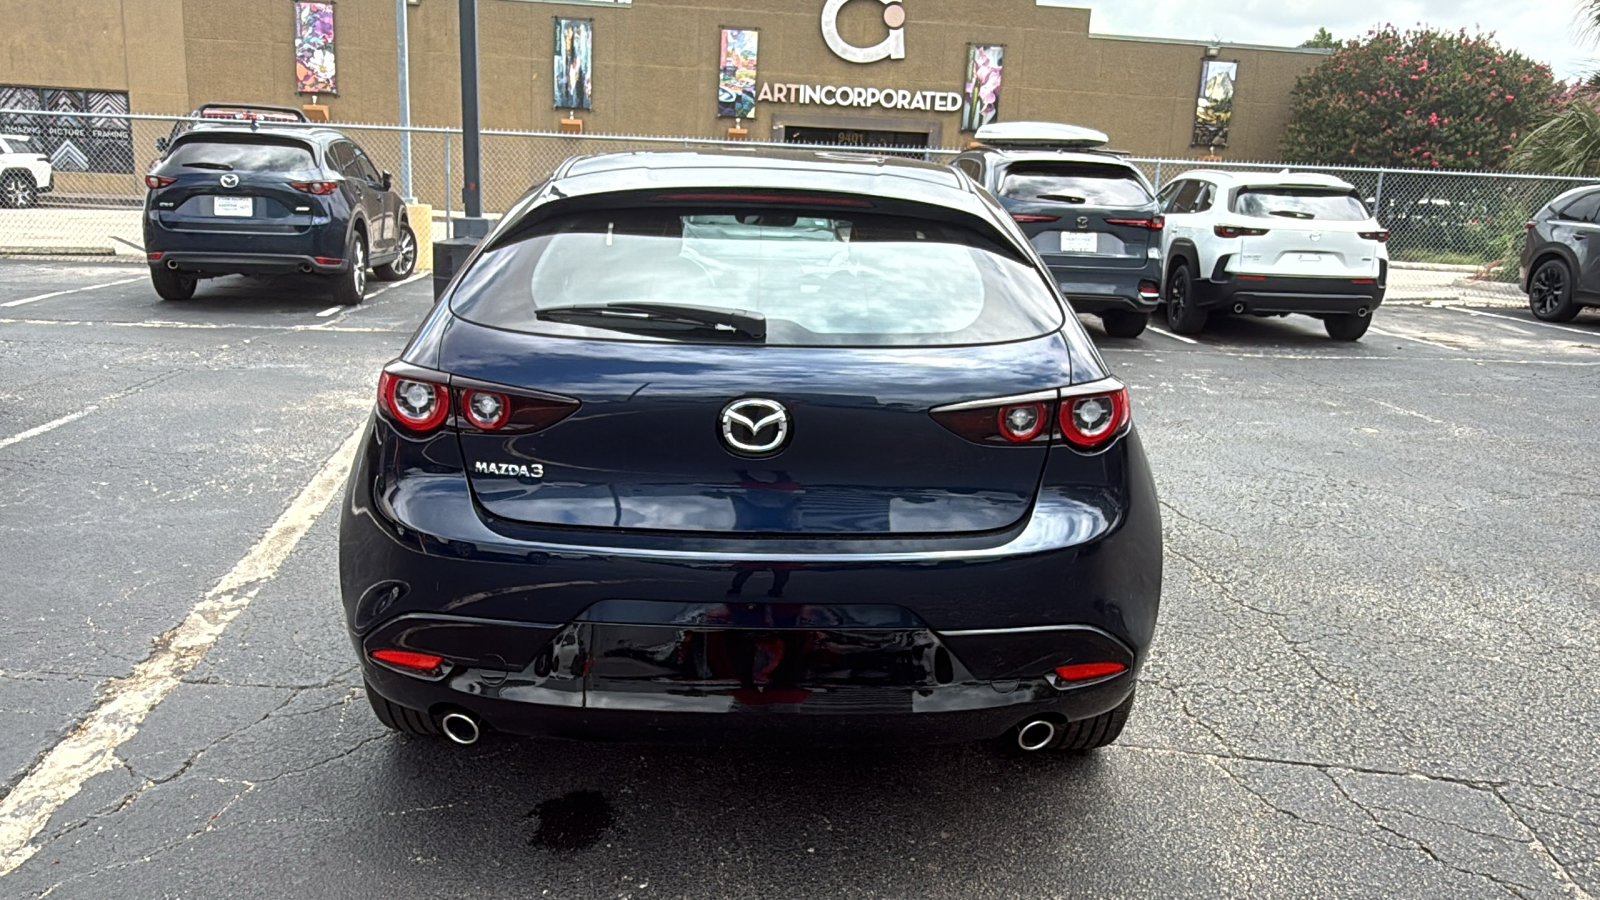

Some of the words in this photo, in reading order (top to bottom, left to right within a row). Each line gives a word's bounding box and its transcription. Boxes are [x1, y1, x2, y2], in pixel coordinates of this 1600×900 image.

[4, 125, 41, 134] AMAZING
[49, 128, 85, 137] PICTURE
[92, 129, 129, 139] FRAMING
